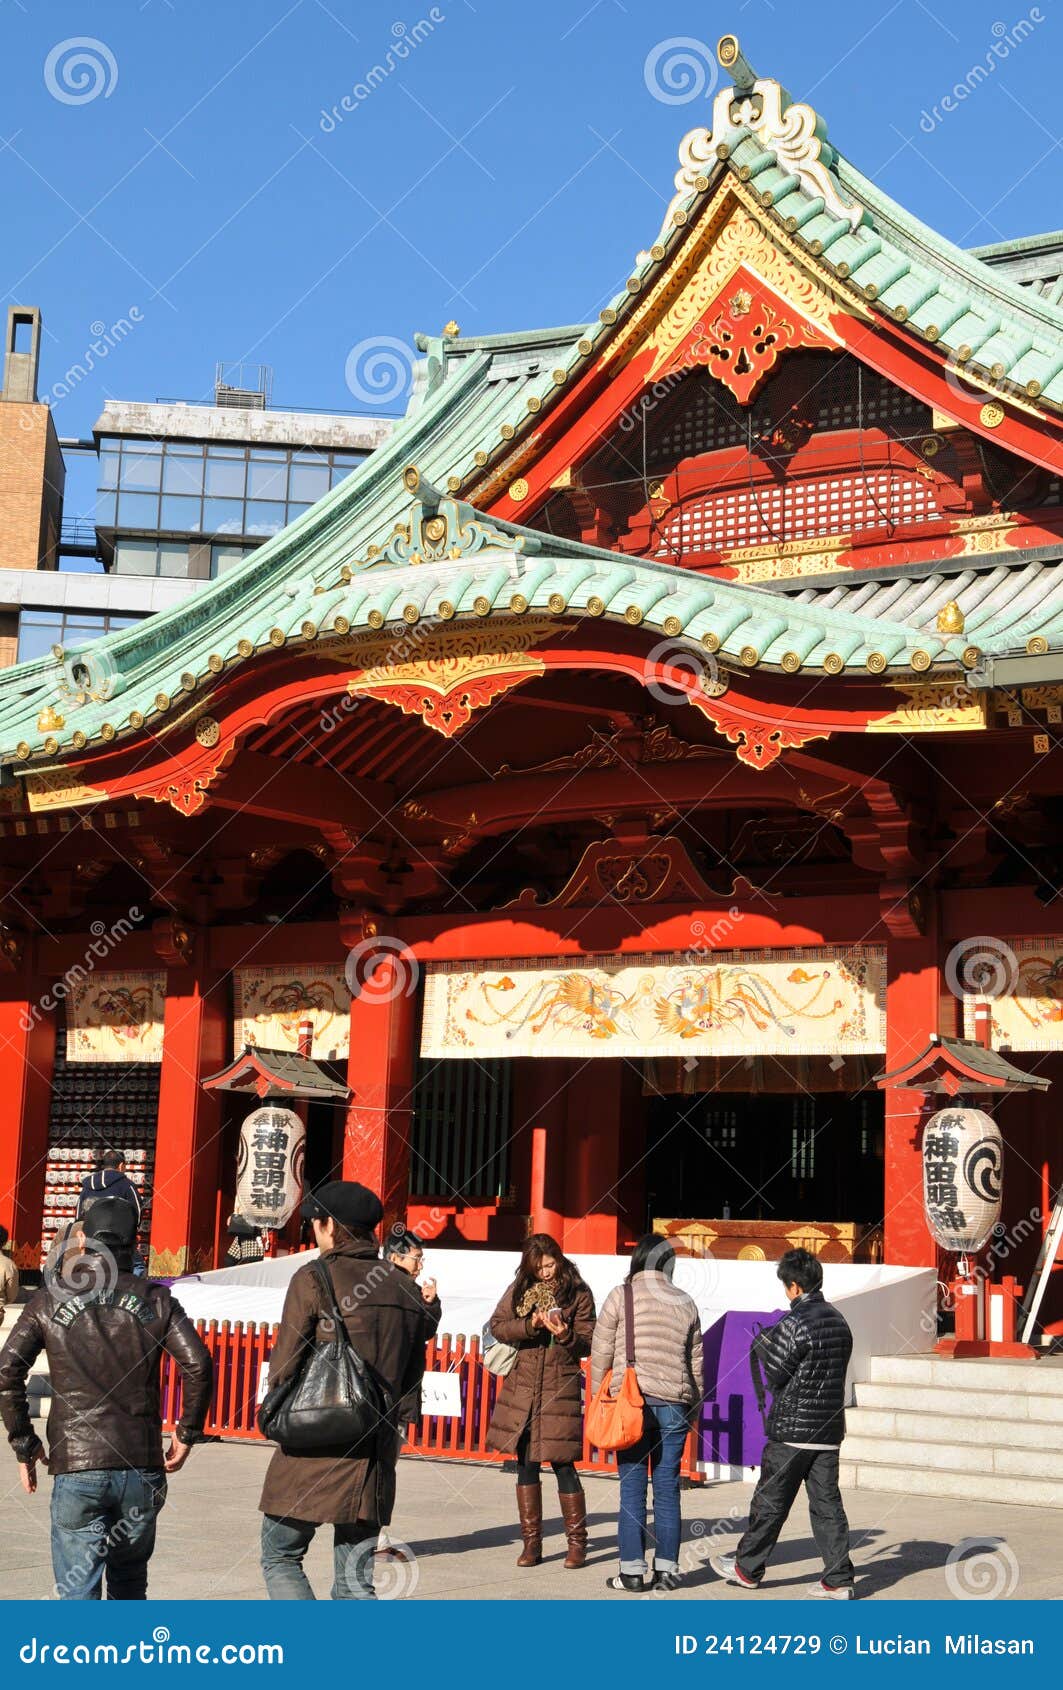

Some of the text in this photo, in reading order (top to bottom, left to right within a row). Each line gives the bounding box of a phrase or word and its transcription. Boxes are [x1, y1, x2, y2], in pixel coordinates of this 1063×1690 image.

[251, 1129, 289, 1211] 神田明神
[924, 1132, 967, 1232] 神田明神
